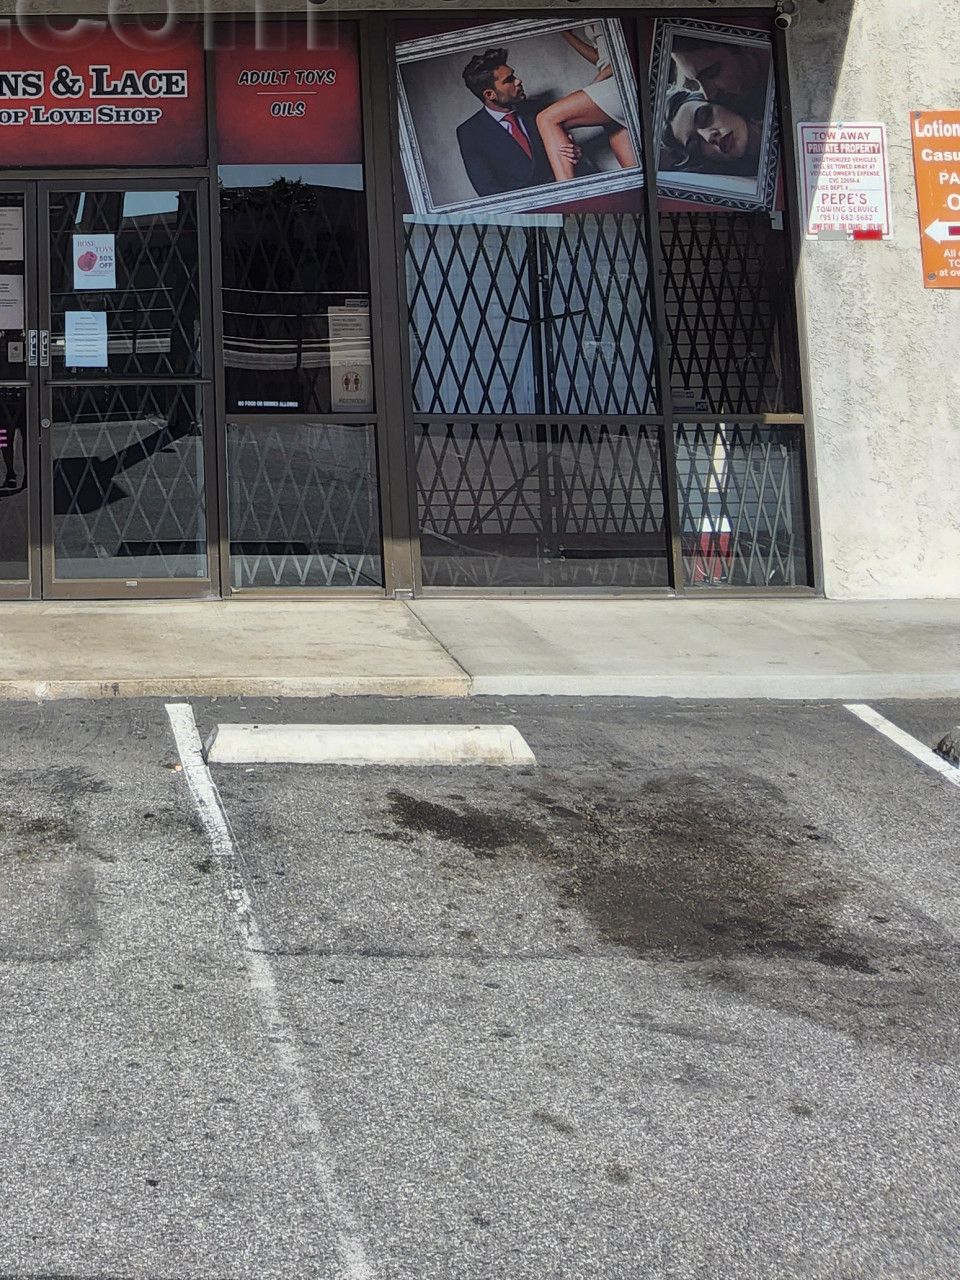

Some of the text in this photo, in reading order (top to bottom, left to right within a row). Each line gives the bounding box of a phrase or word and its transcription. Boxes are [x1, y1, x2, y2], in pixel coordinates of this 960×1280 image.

[50, 65, 83, 98] &
[89, 65, 188, 98] LACE
[238, 69, 336, 85] ADULT TOYS
[30, 106, 93, 126] LOVE
[96, 106, 162, 126] SHOP
[271, 101, 305, 117] OILS
[812, 132, 871, 140] TOW AWAY
[808, 143, 880, 153] PRIVATE PROPERTY
[822, 193, 868, 205] PEPE'S
